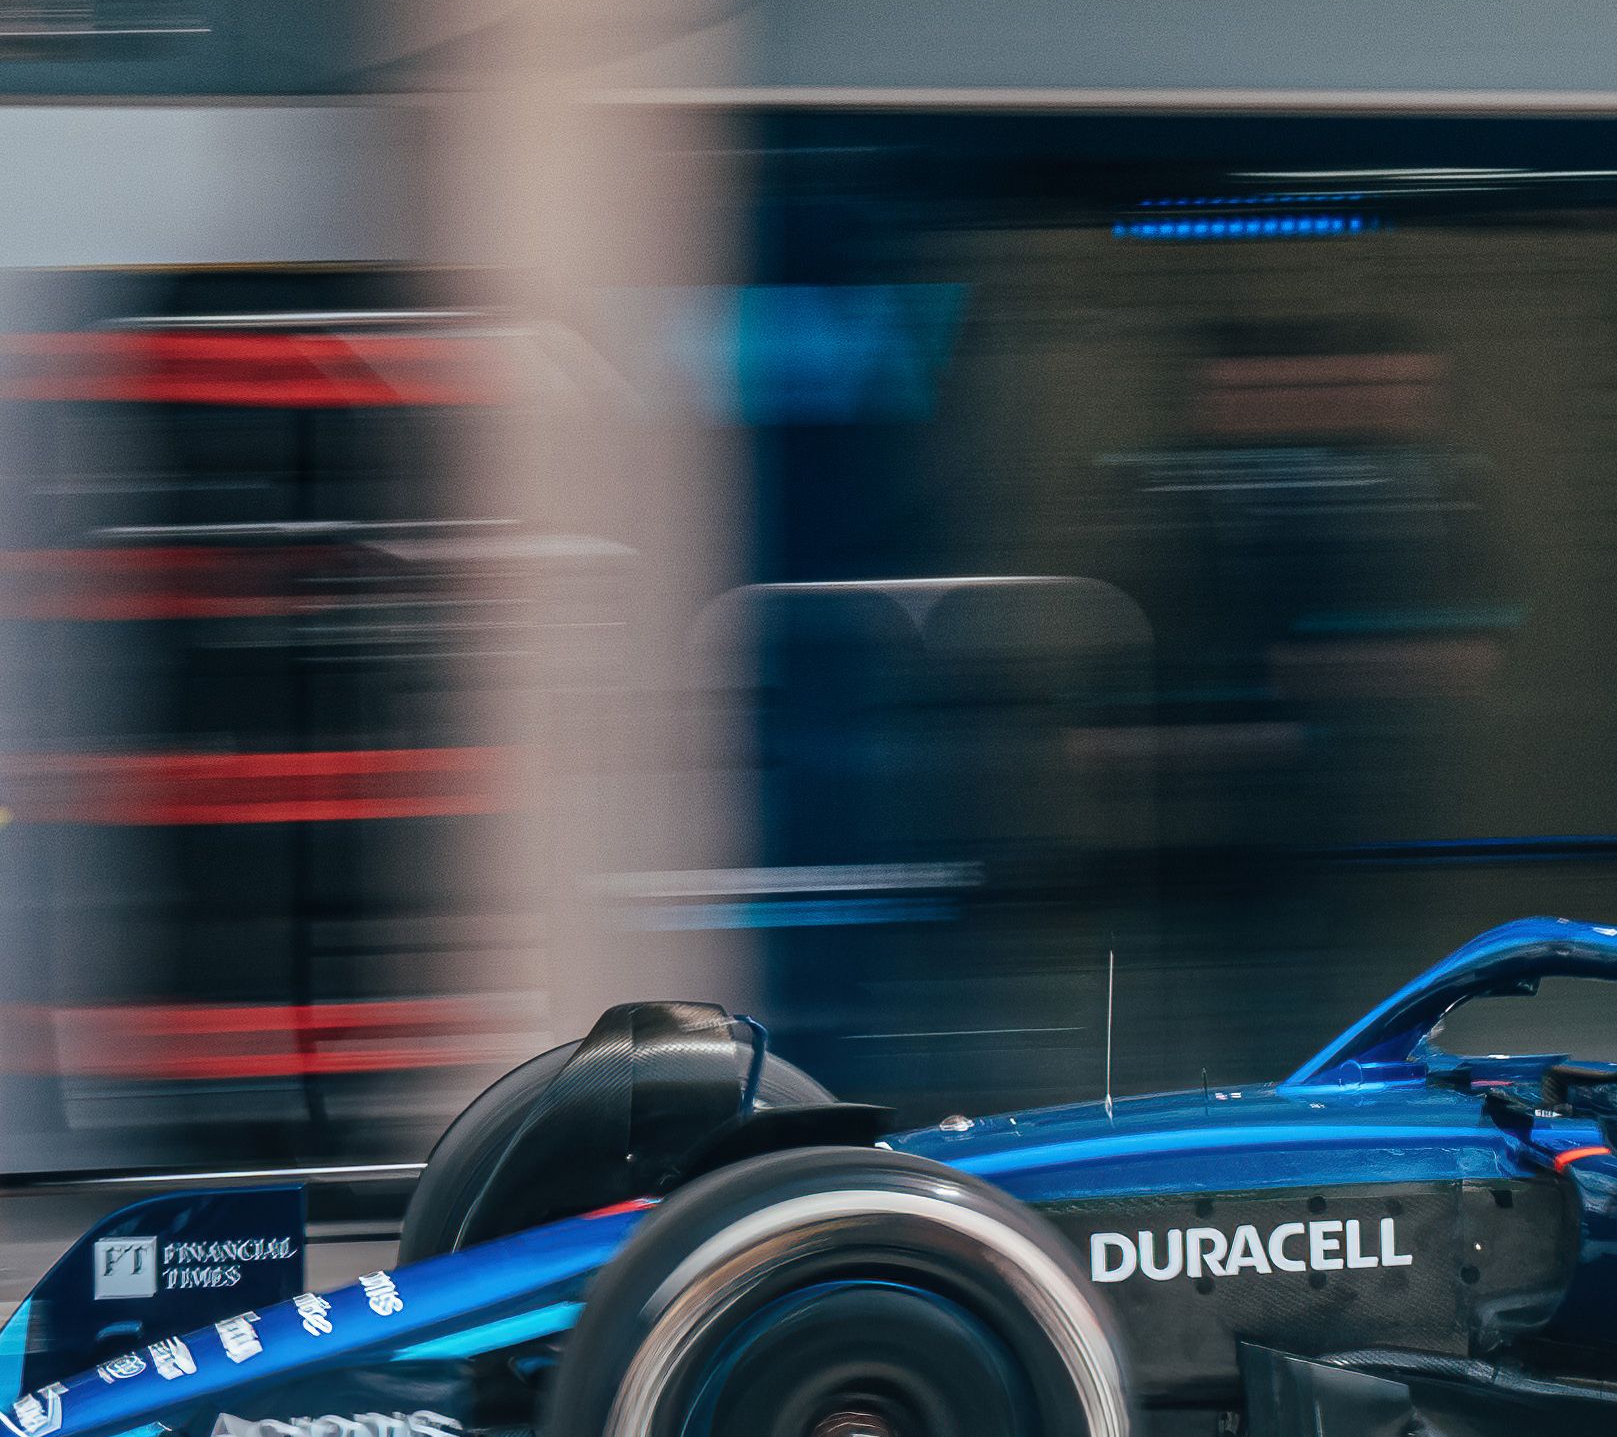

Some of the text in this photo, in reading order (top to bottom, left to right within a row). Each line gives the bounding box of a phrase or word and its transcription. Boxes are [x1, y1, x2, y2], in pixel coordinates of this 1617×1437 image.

[103, 1244, 150, 1277] FT
[163, 1237, 298, 1264] FINANCIAL
[1090, 1218, 1413, 1282] DURACELL
[162, 1265, 242, 1289] TIMES
